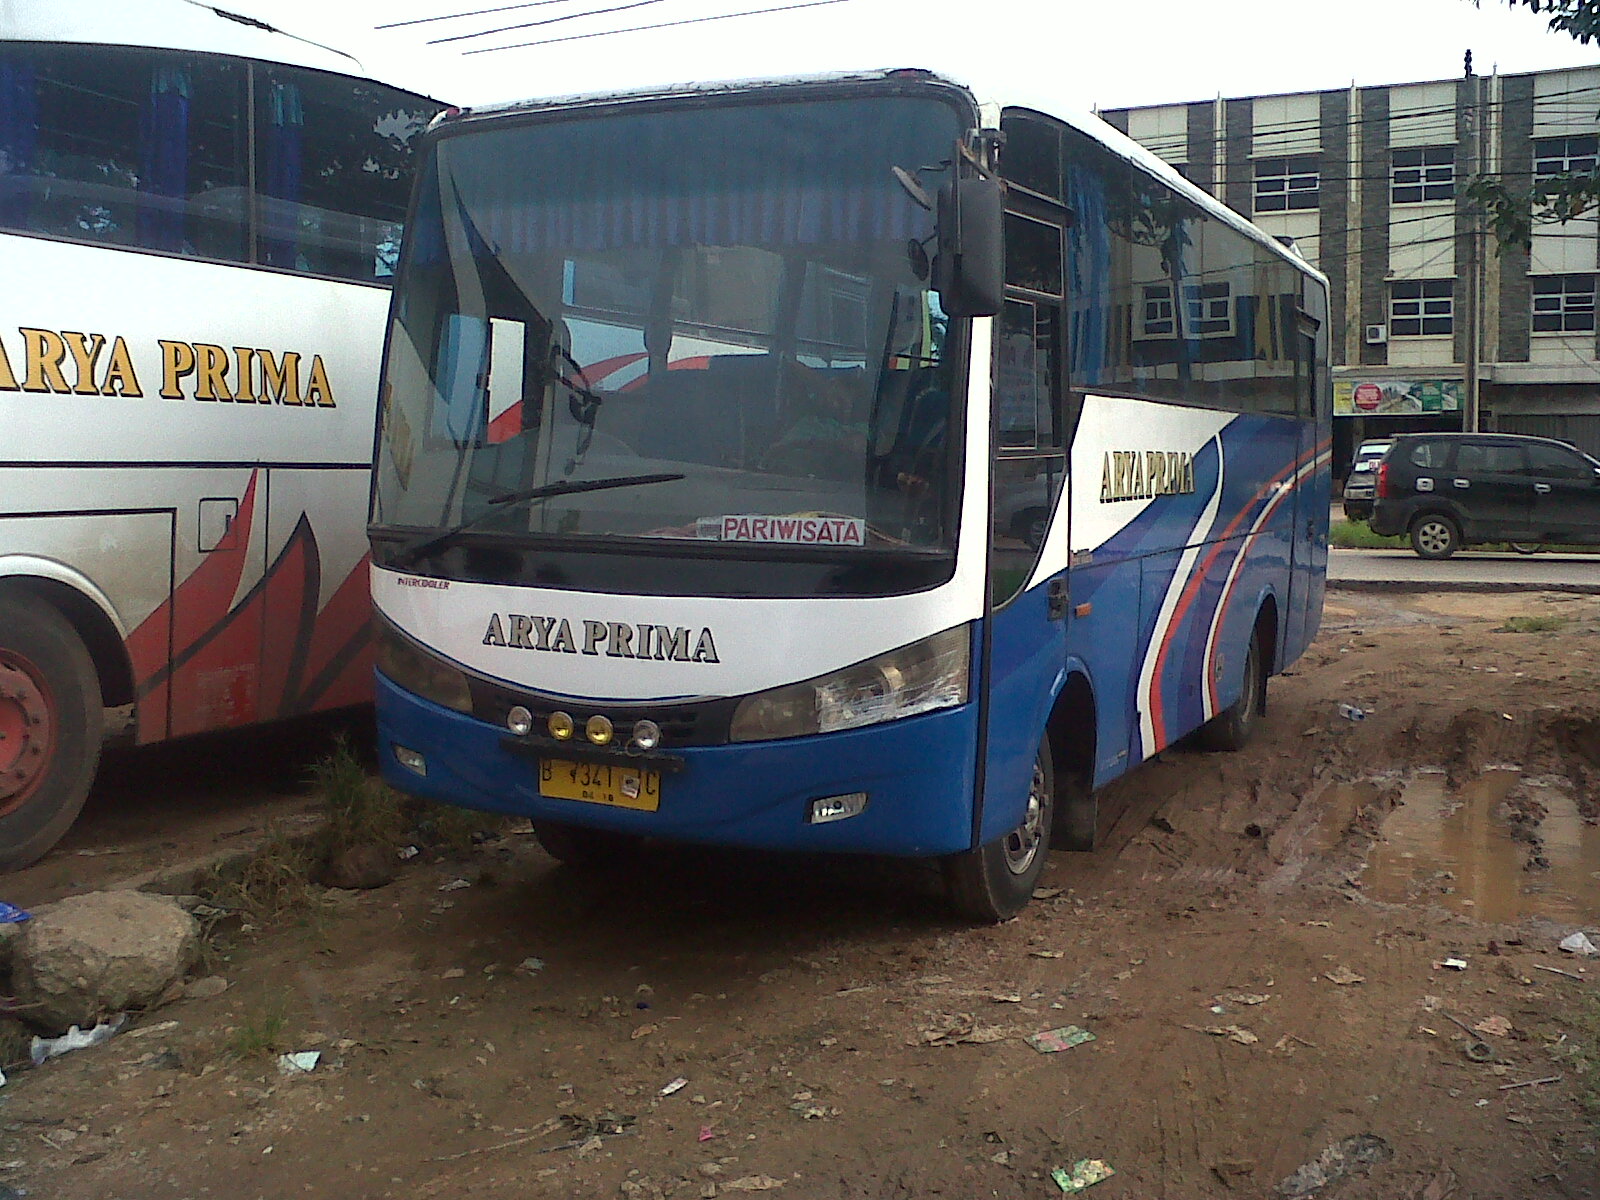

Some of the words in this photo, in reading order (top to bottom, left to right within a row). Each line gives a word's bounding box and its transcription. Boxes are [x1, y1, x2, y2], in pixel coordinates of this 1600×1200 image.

[158, 340, 336, 408] PRIMA
[1100, 451, 1145, 504] ARYA
[1146, 451, 1196, 499] PRIMA
[724, 518, 860, 544] PARIWISATA
[482, 613, 577, 654] ARYA
[582, 620, 720, 663] PRIMA
